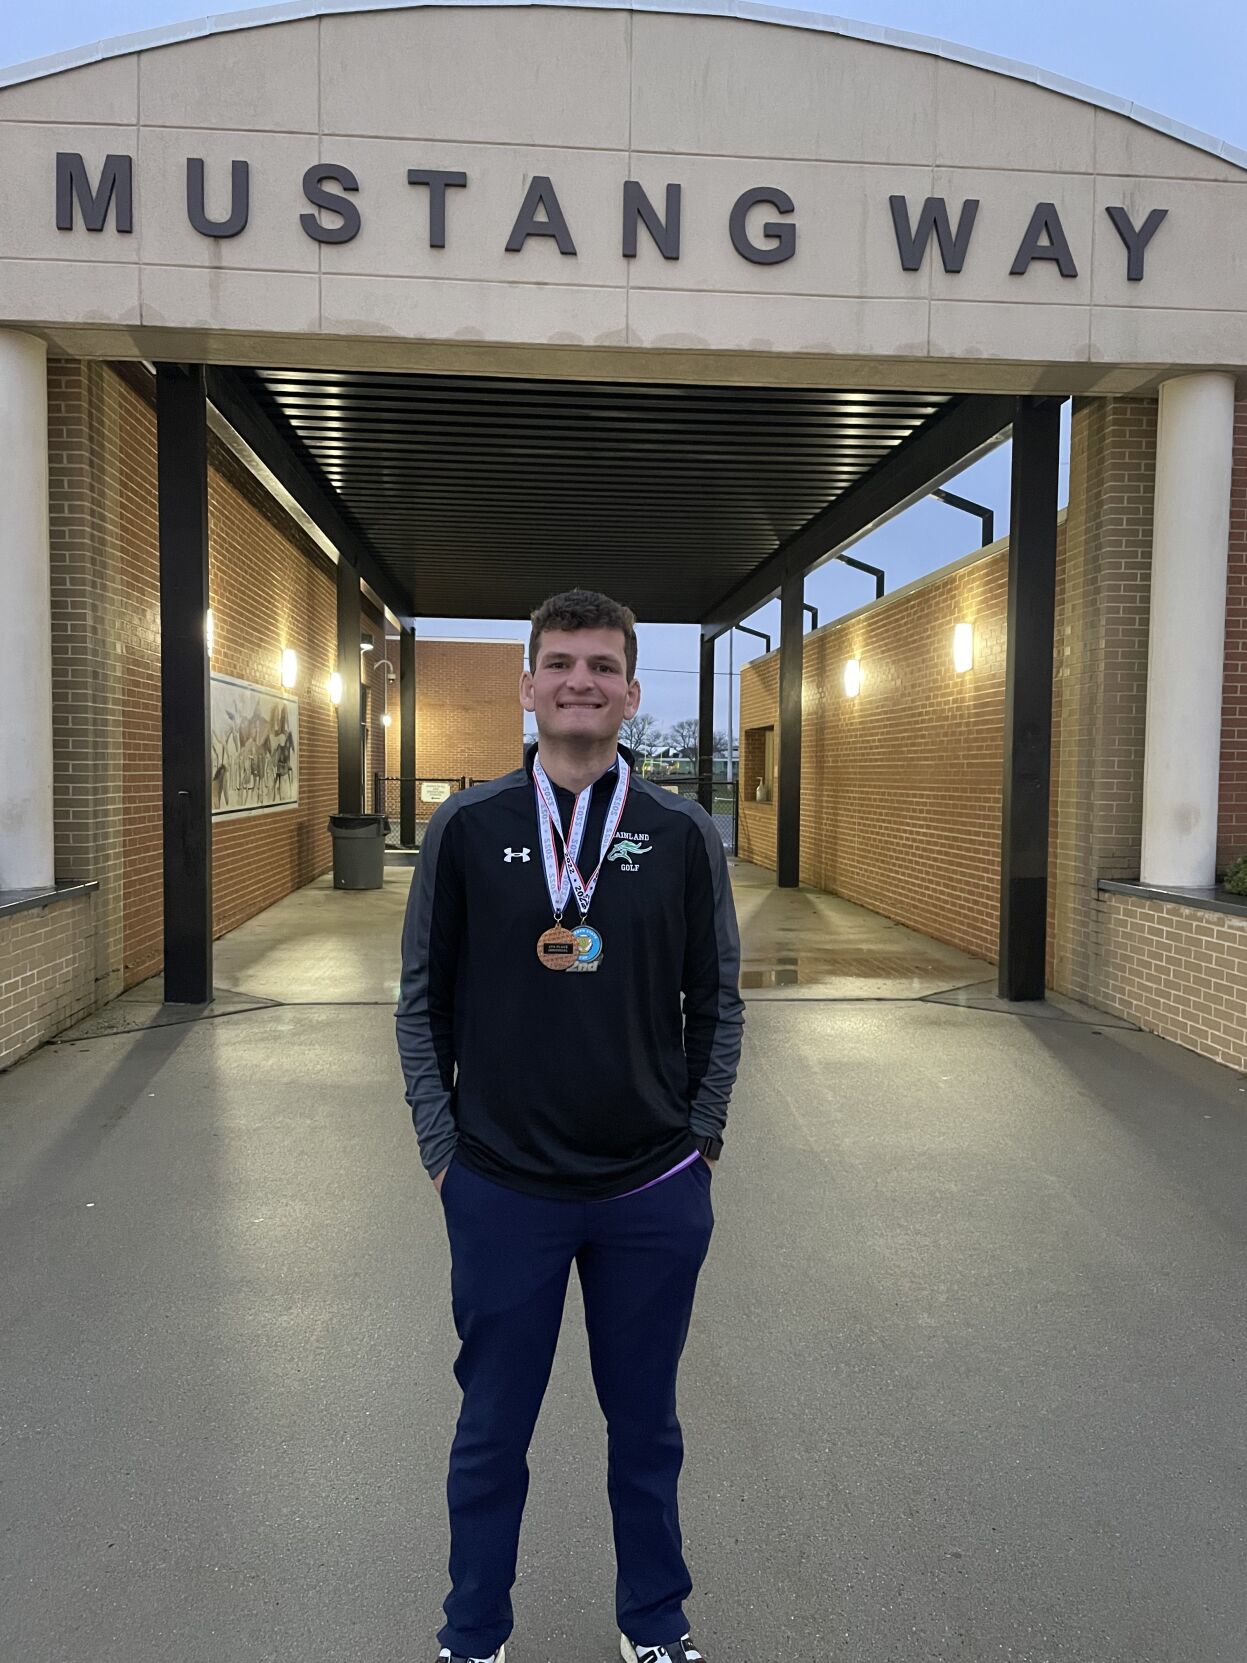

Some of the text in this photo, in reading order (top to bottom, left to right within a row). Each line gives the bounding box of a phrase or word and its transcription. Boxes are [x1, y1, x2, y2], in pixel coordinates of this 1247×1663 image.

[55, 151, 1169, 281] MUSTANG WAY
[614, 831, 650, 841] AINLAND
[620, 863, 640, 872] GOLF
